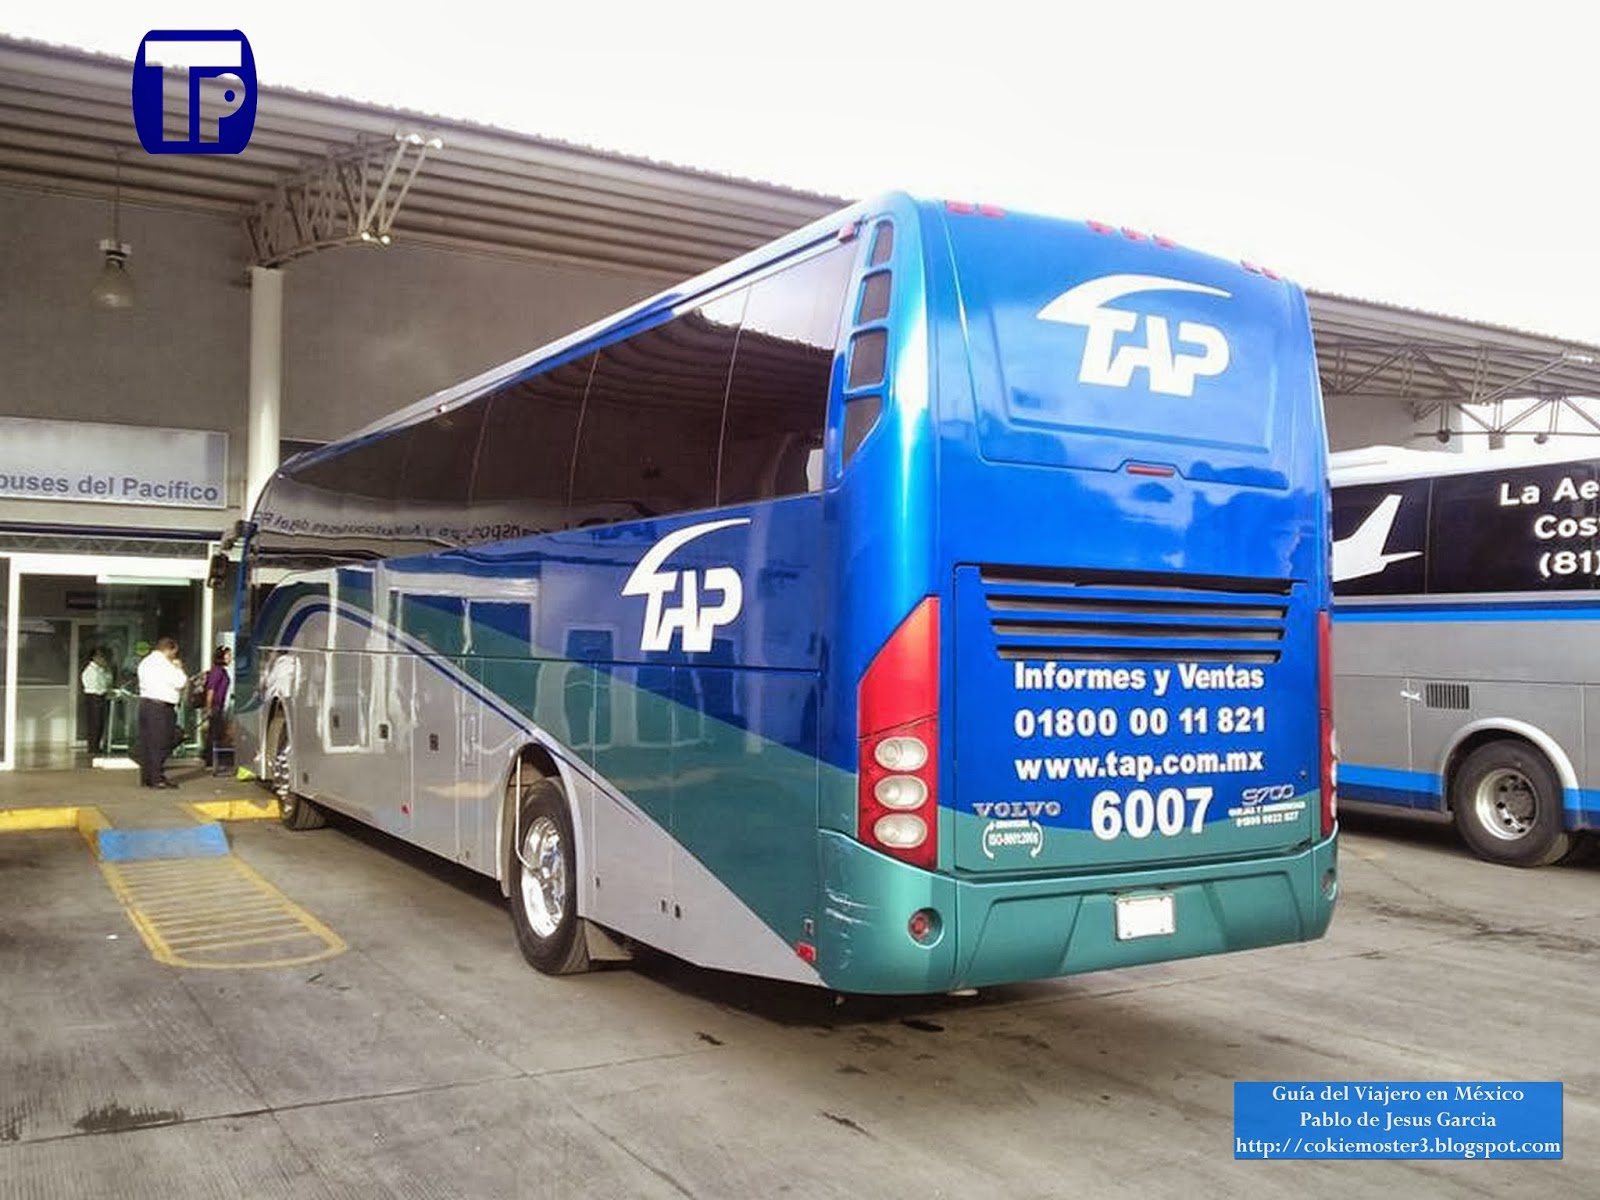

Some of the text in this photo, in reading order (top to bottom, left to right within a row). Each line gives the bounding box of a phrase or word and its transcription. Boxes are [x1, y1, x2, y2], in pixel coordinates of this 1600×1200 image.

[1036, 273, 1232, 397] TAP
[78, 475, 114, 495] del
[1500, 477, 1600, 506] La Ae
[1534, 514, 1600, 540] Cos
[621, 518, 751, 652] TAP
[1014, 662, 1264, 696] Informes y Ventas
[1014, 706, 1265, 738] 01800 00 11 821
[1014, 750, 1264, 783] www.tap.com.mx
[972, 801, 1061, 818] VOLVO
[1091, 786, 1213, 841] 6007
